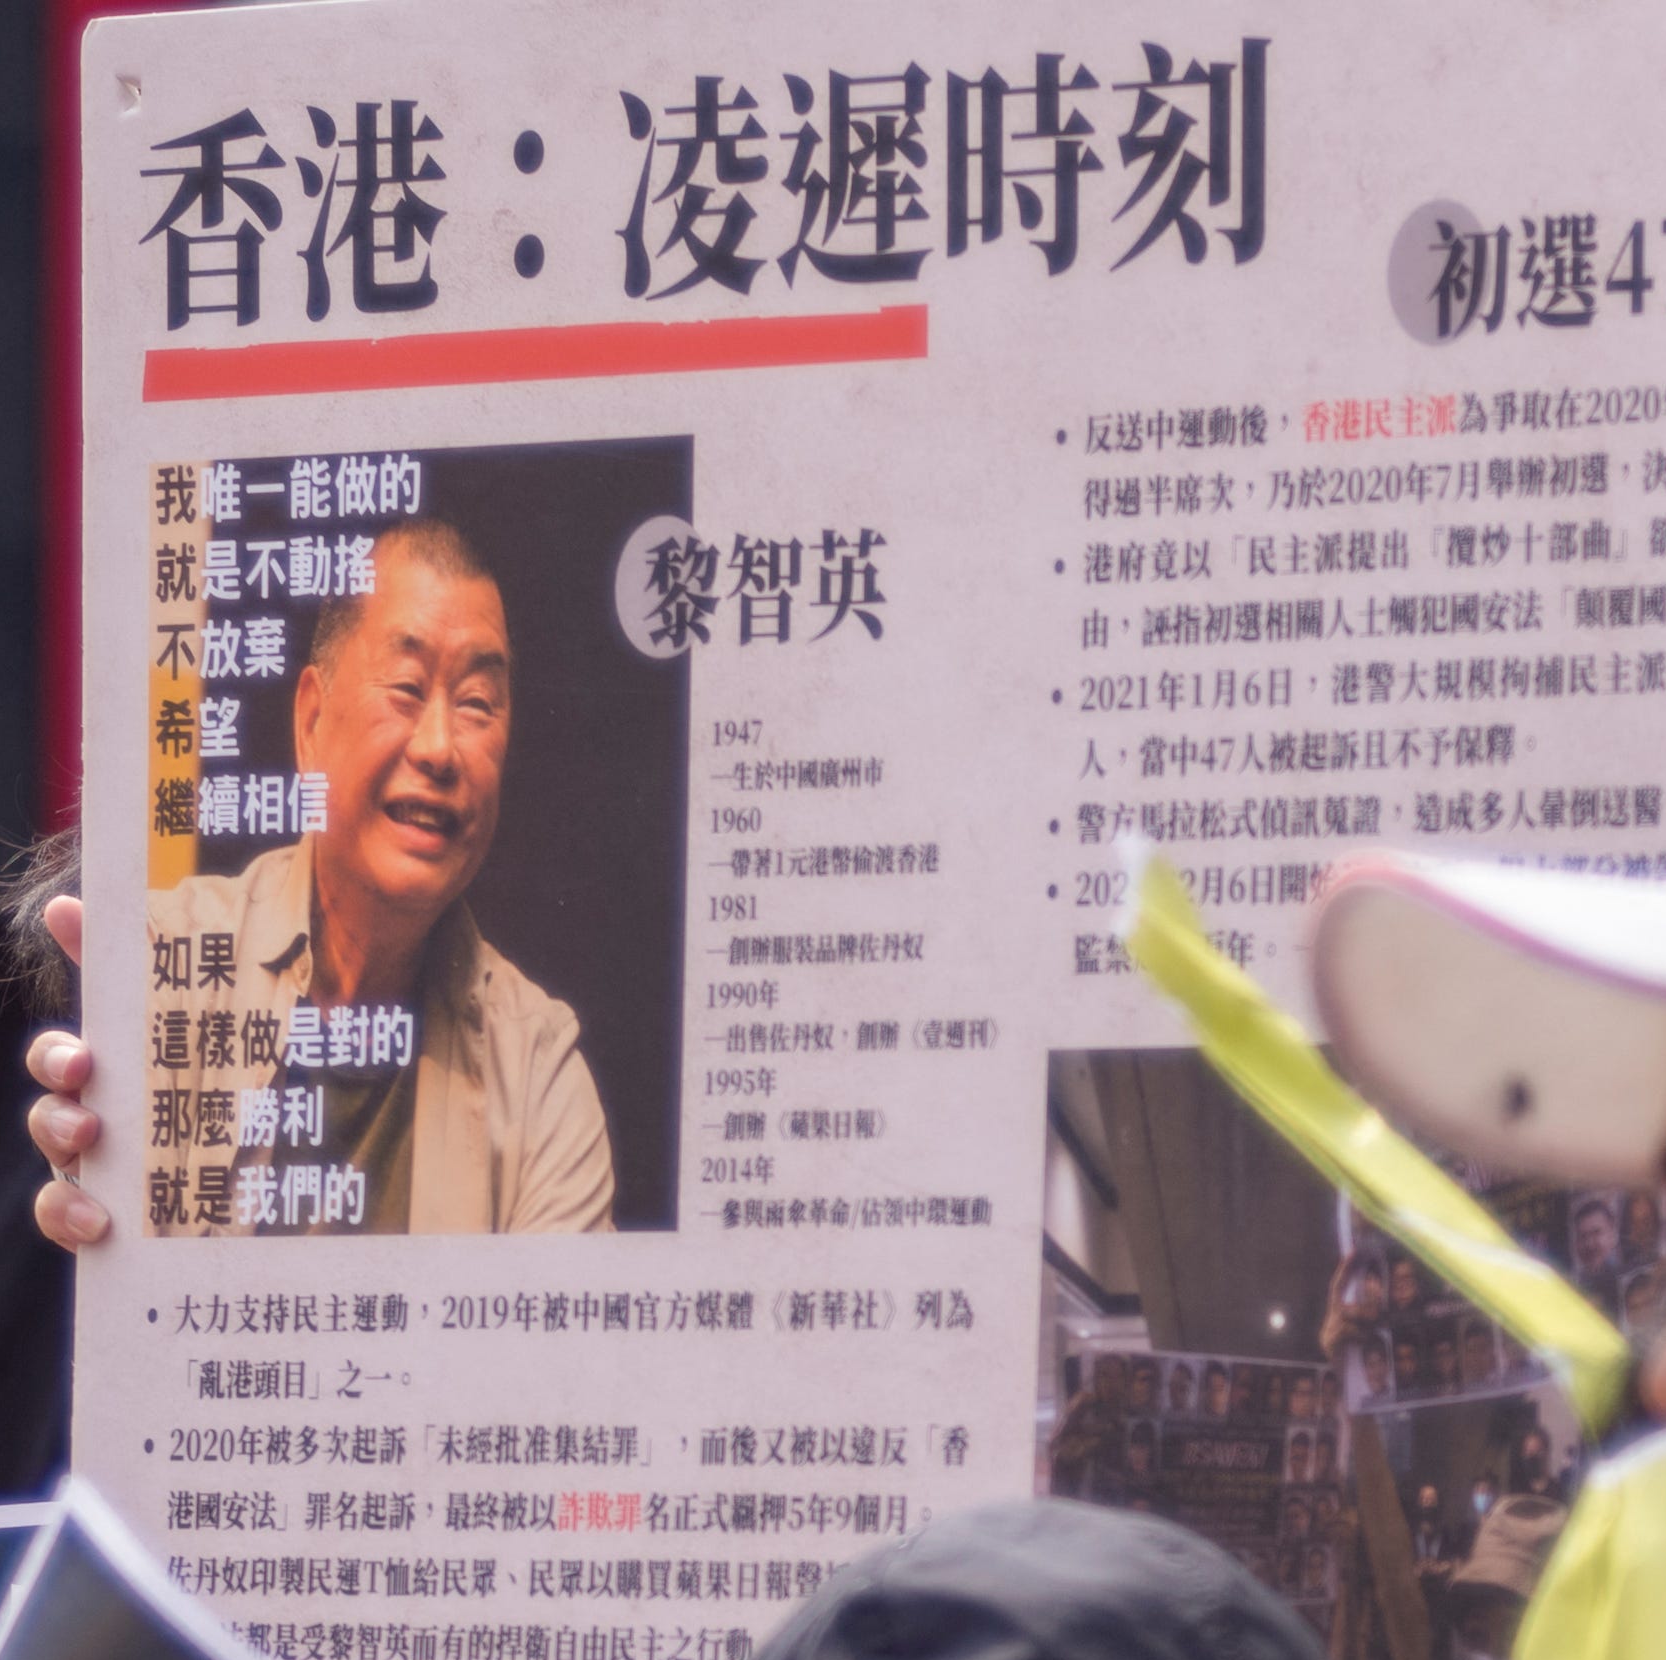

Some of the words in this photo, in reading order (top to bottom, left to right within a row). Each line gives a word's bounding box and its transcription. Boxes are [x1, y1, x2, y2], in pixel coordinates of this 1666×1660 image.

[138, 38, 1267, 331] 香港：凌遲時刻
[154, 453, 422, 525] 我唯一能做的
[154, 534, 377, 604] 就是不動搖
[643, 527, 889, 648] 黎智英
[154, 616, 287, 681] 不放棄
[153, 695, 241, 759] 希望
[712, 718, 763, 747] 1947
[153, 772, 330, 838] 繼續相信
[710, 806, 762, 834] 1960
[708, 894, 758, 922] 1981
[151, 932, 238, 992] 如果
[705, 979, 780, 1010] 1990年
[150, 1004, 414, 1070] 這樣做是對的
[703, 1066, 778, 1097] 1995年
[150, 1084, 325, 1148] 那麼勝利
[148, 1163, 366, 1226] 就是我們的
[700, 1154, 775, 1186] 2014年
[186, 1358, 412, 1401] 「亂港頭目」之一。
[167, 1555, 845, 1601] 佐丹奴印製民運T恤給民眾、民眾以購買蘋果日報聲
